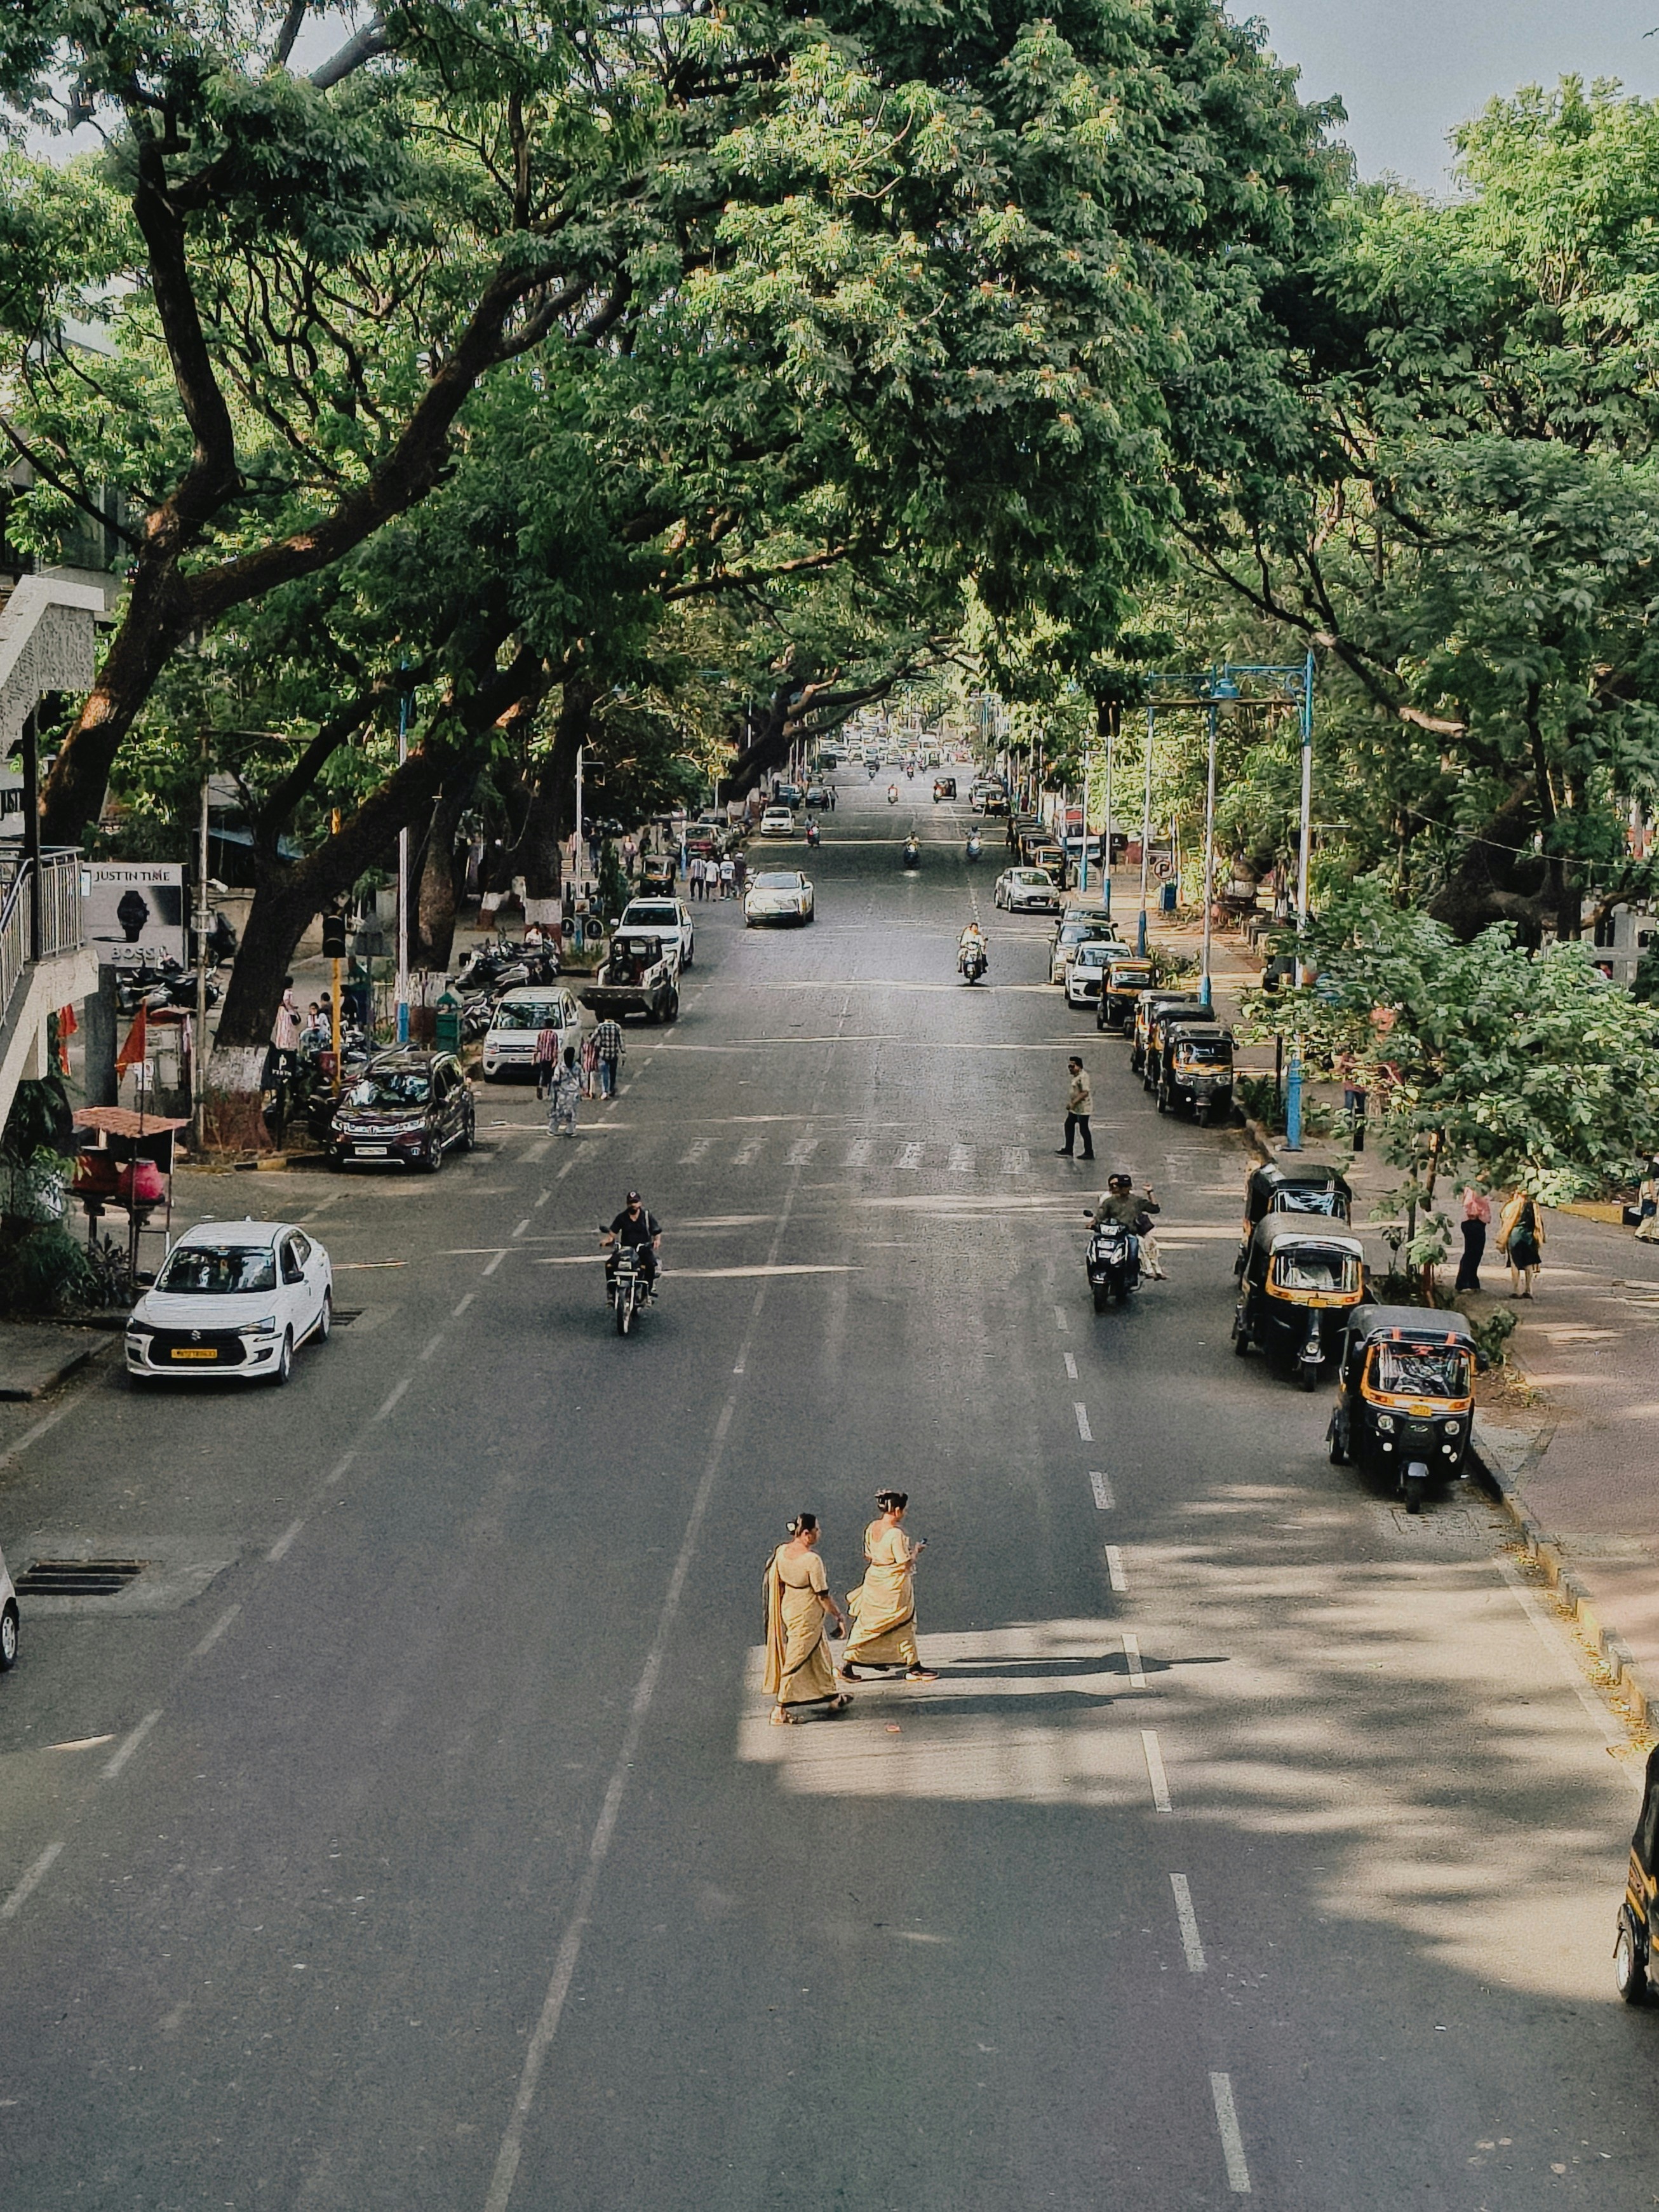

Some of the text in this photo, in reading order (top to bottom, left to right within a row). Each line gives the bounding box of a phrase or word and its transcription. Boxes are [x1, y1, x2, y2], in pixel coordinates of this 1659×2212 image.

[95, 868, 170, 882] JUST IN TIME
[111, 948, 155, 960] BOSS
